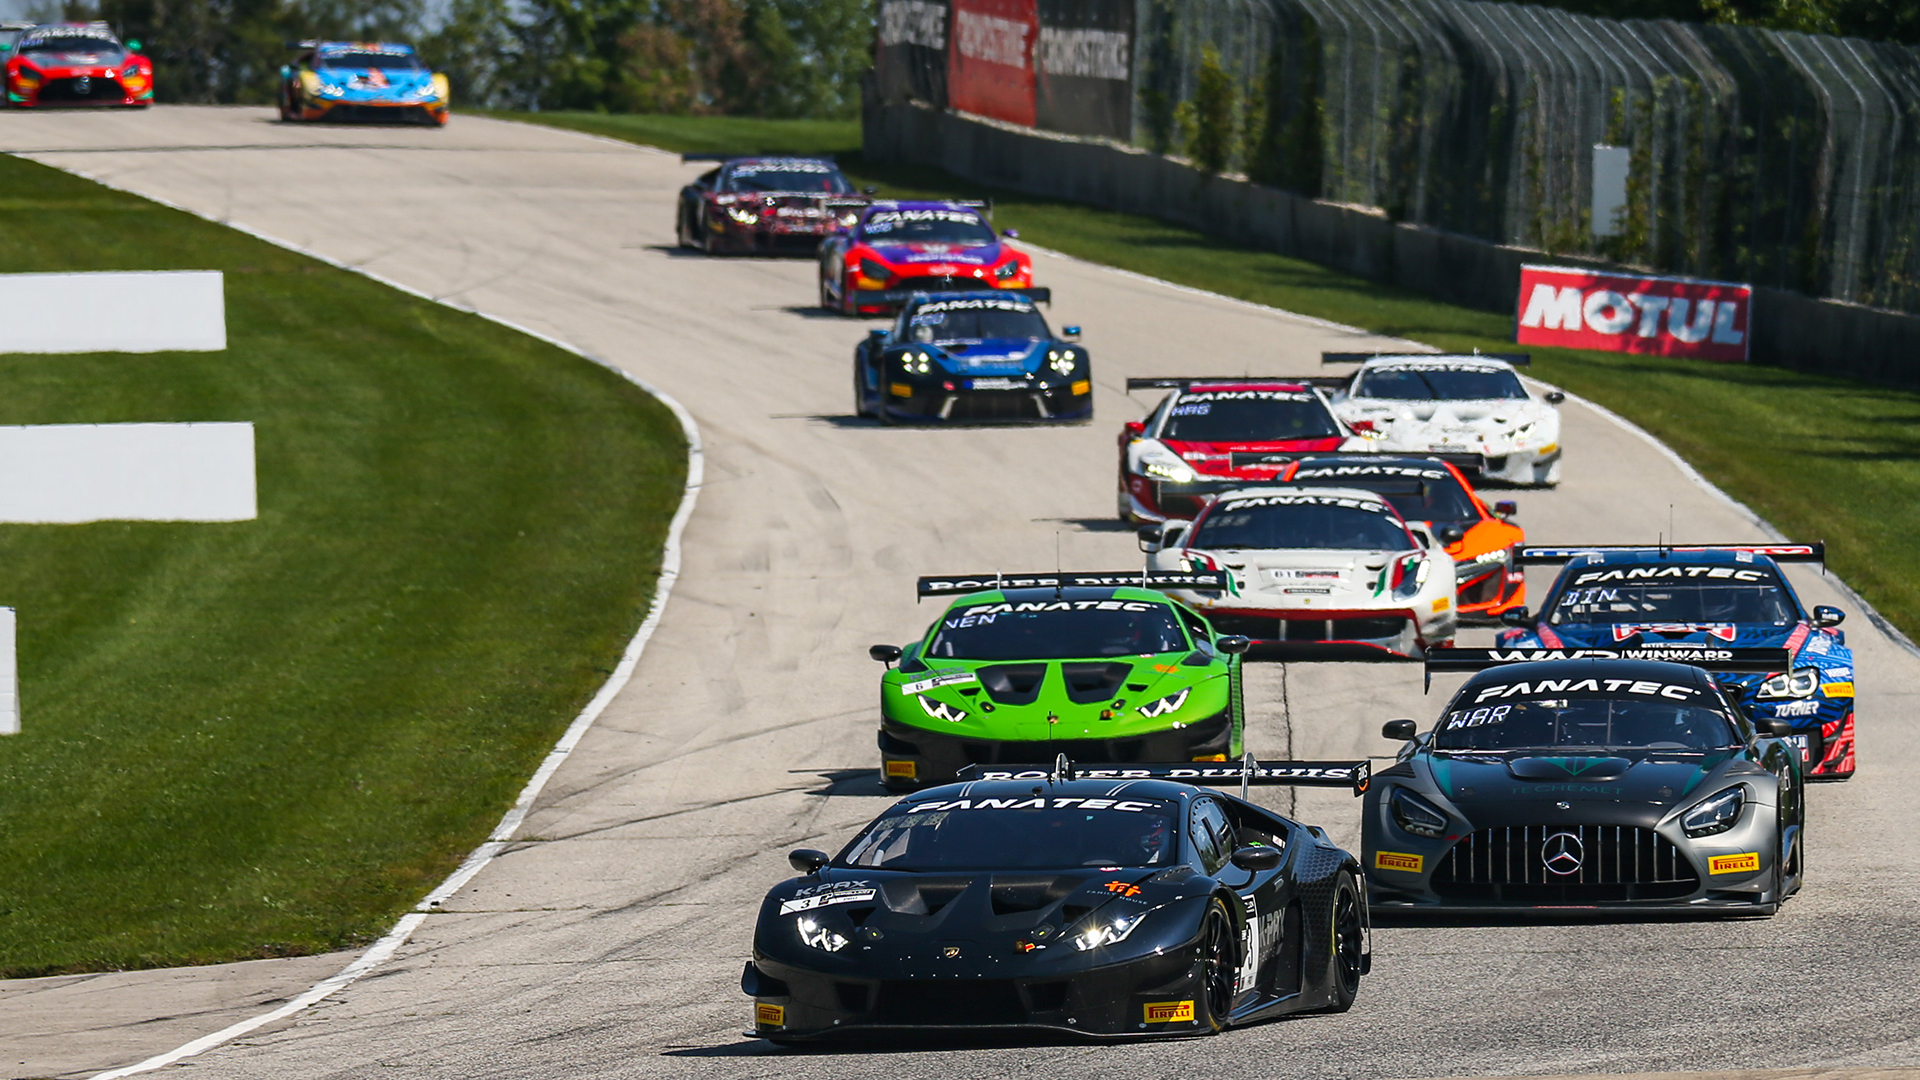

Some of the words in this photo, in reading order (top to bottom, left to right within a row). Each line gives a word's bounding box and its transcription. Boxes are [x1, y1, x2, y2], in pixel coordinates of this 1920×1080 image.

[871, 210, 979, 225] FANATEC
[917, 299, 1033, 316] FANATEC
[1520, 283, 1744, 345] MOTUL
[1178, 390, 1314, 405] FANATEC
[1293, 465, 1449, 480] FANATEC
[1224, 496, 1389, 513] FANATEC
[1574, 565, 1769, 585] FANATEC
[963, 601, 1157, 617] FANATEC
[945, 613, 997, 629] VEN
[1626, 650, 1733, 659] WINWARD
[1474, 679, 1701, 704] FANATEC
[1775, 701, 1820, 717] TURNER
[1446, 705, 1512, 731] WAR
[983, 770, 1152, 781] ROER
[1357, 764, 1368, 780] aws
[1511, 784, 1623, 795] TECHEMET
[907, 797, 1162, 814] FANATEC
[1379, 854, 1419, 869] PIRELLI
[1713, 856, 1755, 871] PIRELLI
[795, 879, 870, 898] K-PAX
[1148, 1005, 1190, 1019] PIRELLI
